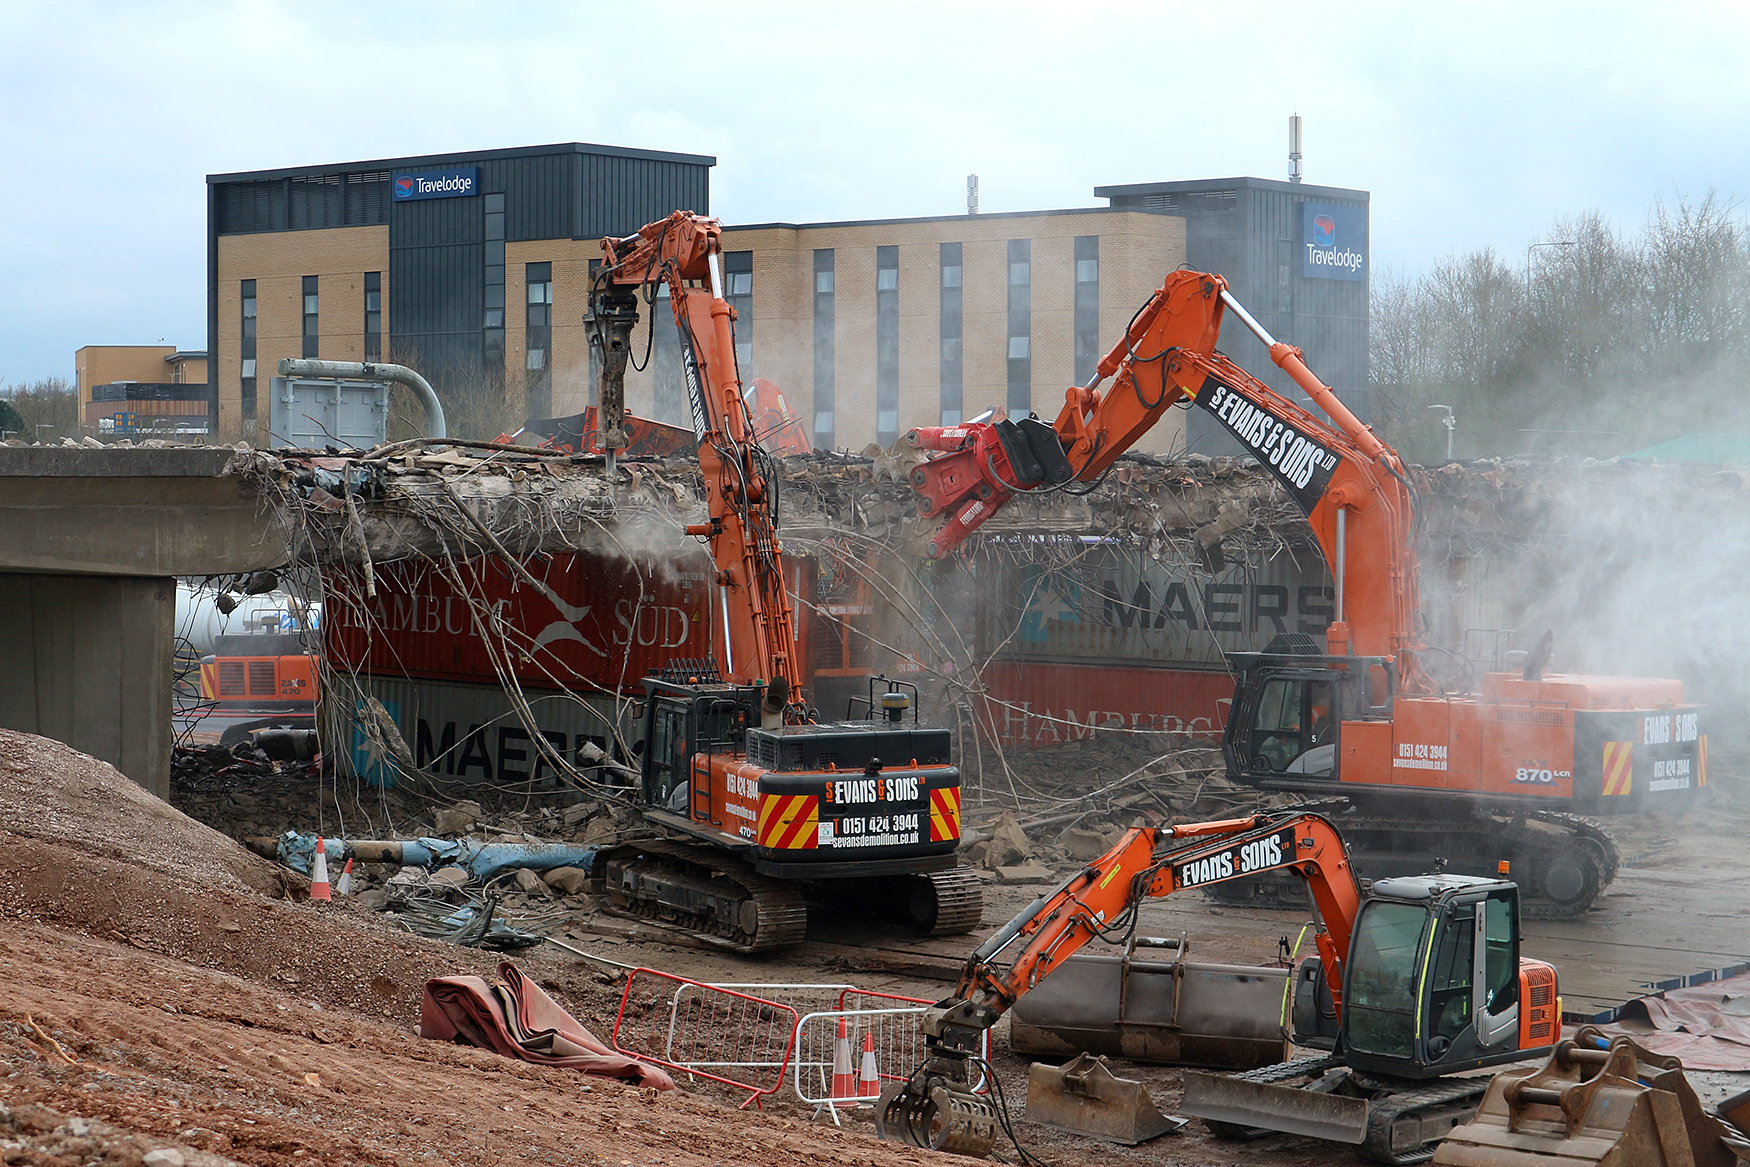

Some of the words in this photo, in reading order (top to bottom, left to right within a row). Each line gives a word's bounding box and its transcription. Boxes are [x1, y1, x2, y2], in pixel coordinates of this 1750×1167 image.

[416, 175, 472, 194] Travelodge
[1306, 243, 1363, 273] Travelodge
[1217, 392, 1274, 449] EVANS
[1269, 429, 1325, 490] SONS
[343, 585, 515, 638] HAMBURG
[1103, 580, 1336, 634] MAERS
[612, 594, 689, 648] SÜD
[281, 678, 306, 687] ZAXIS
[1311, 735, 1317, 743] 5
[1644, 714, 1670, 745] EVANS
[1675, 713, 1698, 742] SONS
[1399, 743, 1414, 757] 0151
[1415, 744, 1428, 758] 424
[1430, 745, 1447, 759] 3944
[1516, 767, 1553, 783] 870
[825, 781, 834, 803] S
[834, 779, 877, 804] EVANS
[885, 777, 919, 802] SONS
[739, 825, 752, 838] 470
[833, 818, 840, 834] T
[842, 817, 866, 835] 0151
[868, 816, 890, 833] 424
[892, 813, 919, 832] 3944
[832, 831, 919, 849] sevansdemolition.co.uk
[1182, 851, 1233, 887] EVANS
[1240, 834, 1282, 873] SONS
